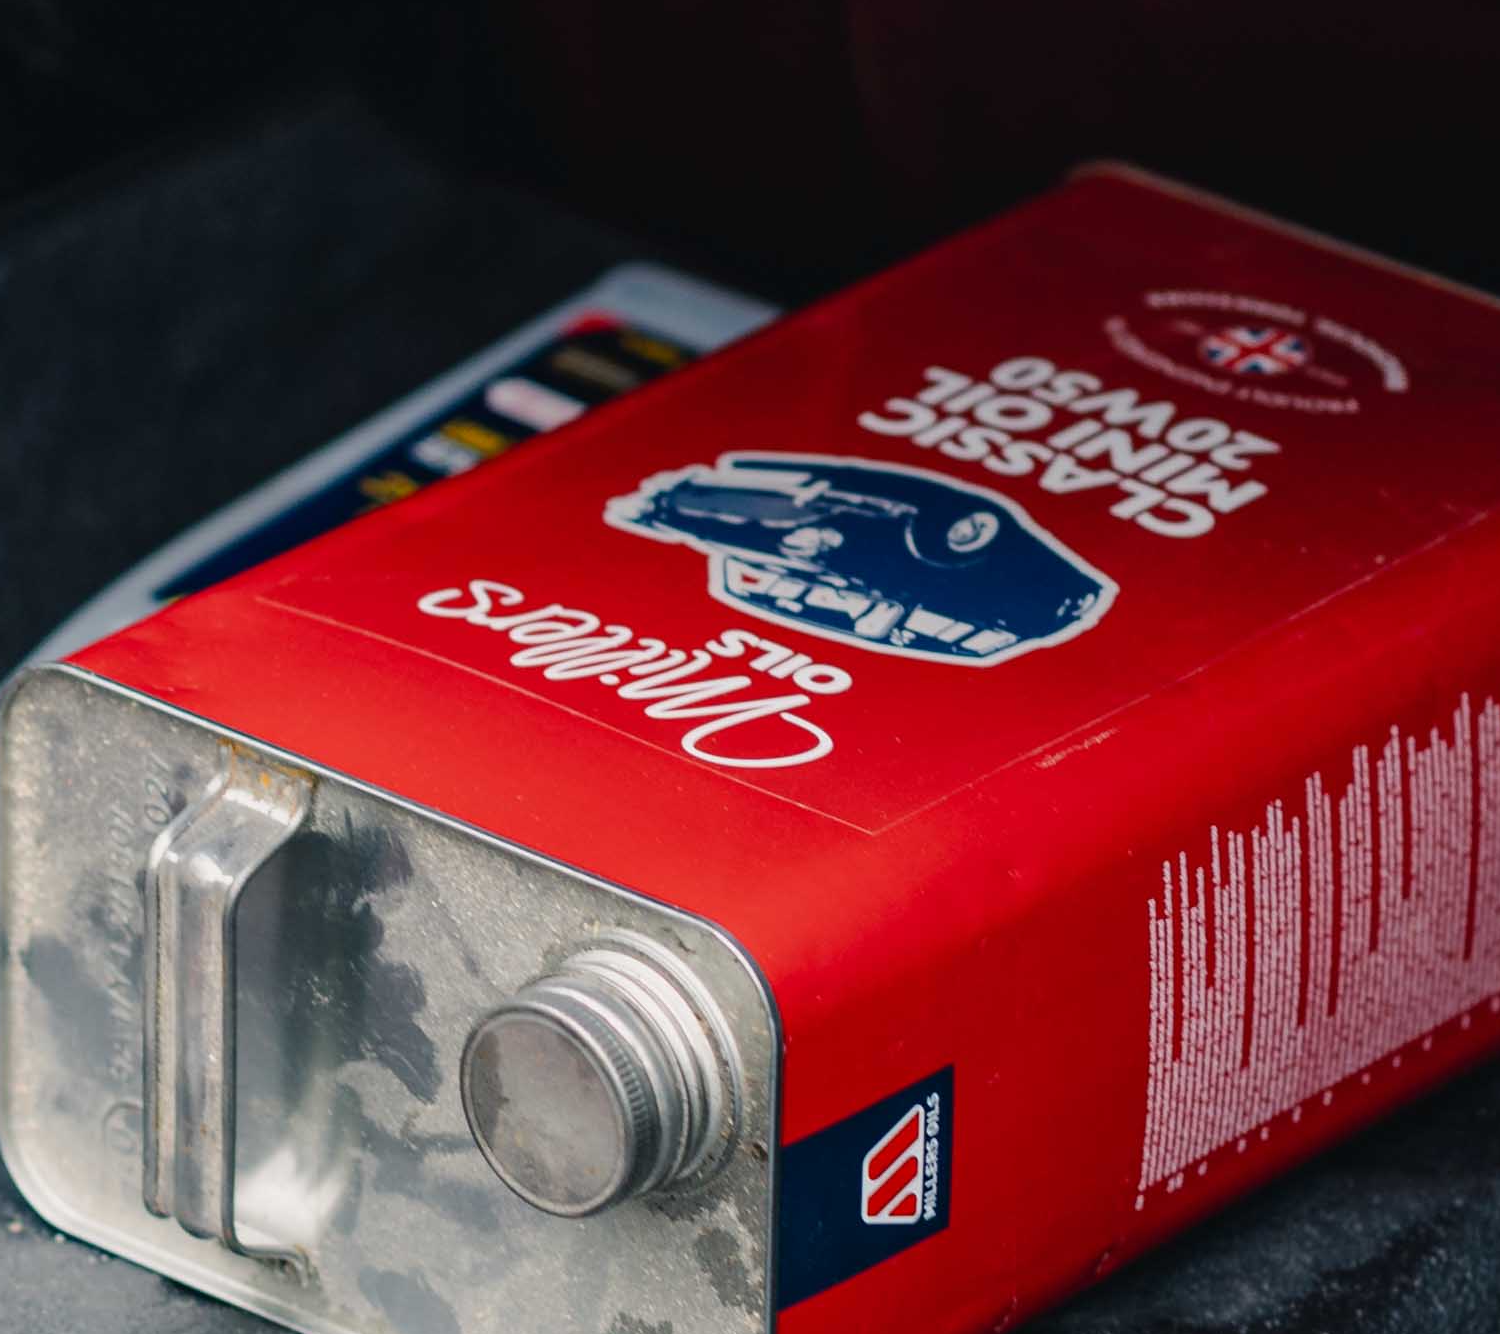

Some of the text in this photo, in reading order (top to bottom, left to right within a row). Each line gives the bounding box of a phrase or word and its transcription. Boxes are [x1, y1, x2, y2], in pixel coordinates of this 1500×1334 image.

[857, 398, 1215, 539] CLASSIC
[917, 366, 1268, 513] MINI OIL
[989, 356, 1281, 471] 20W50
[417, 579, 834, 768] Millers
[706, 628, 853, 695] OILS
[923, 1092, 940, 1221] MILLERS OILS
